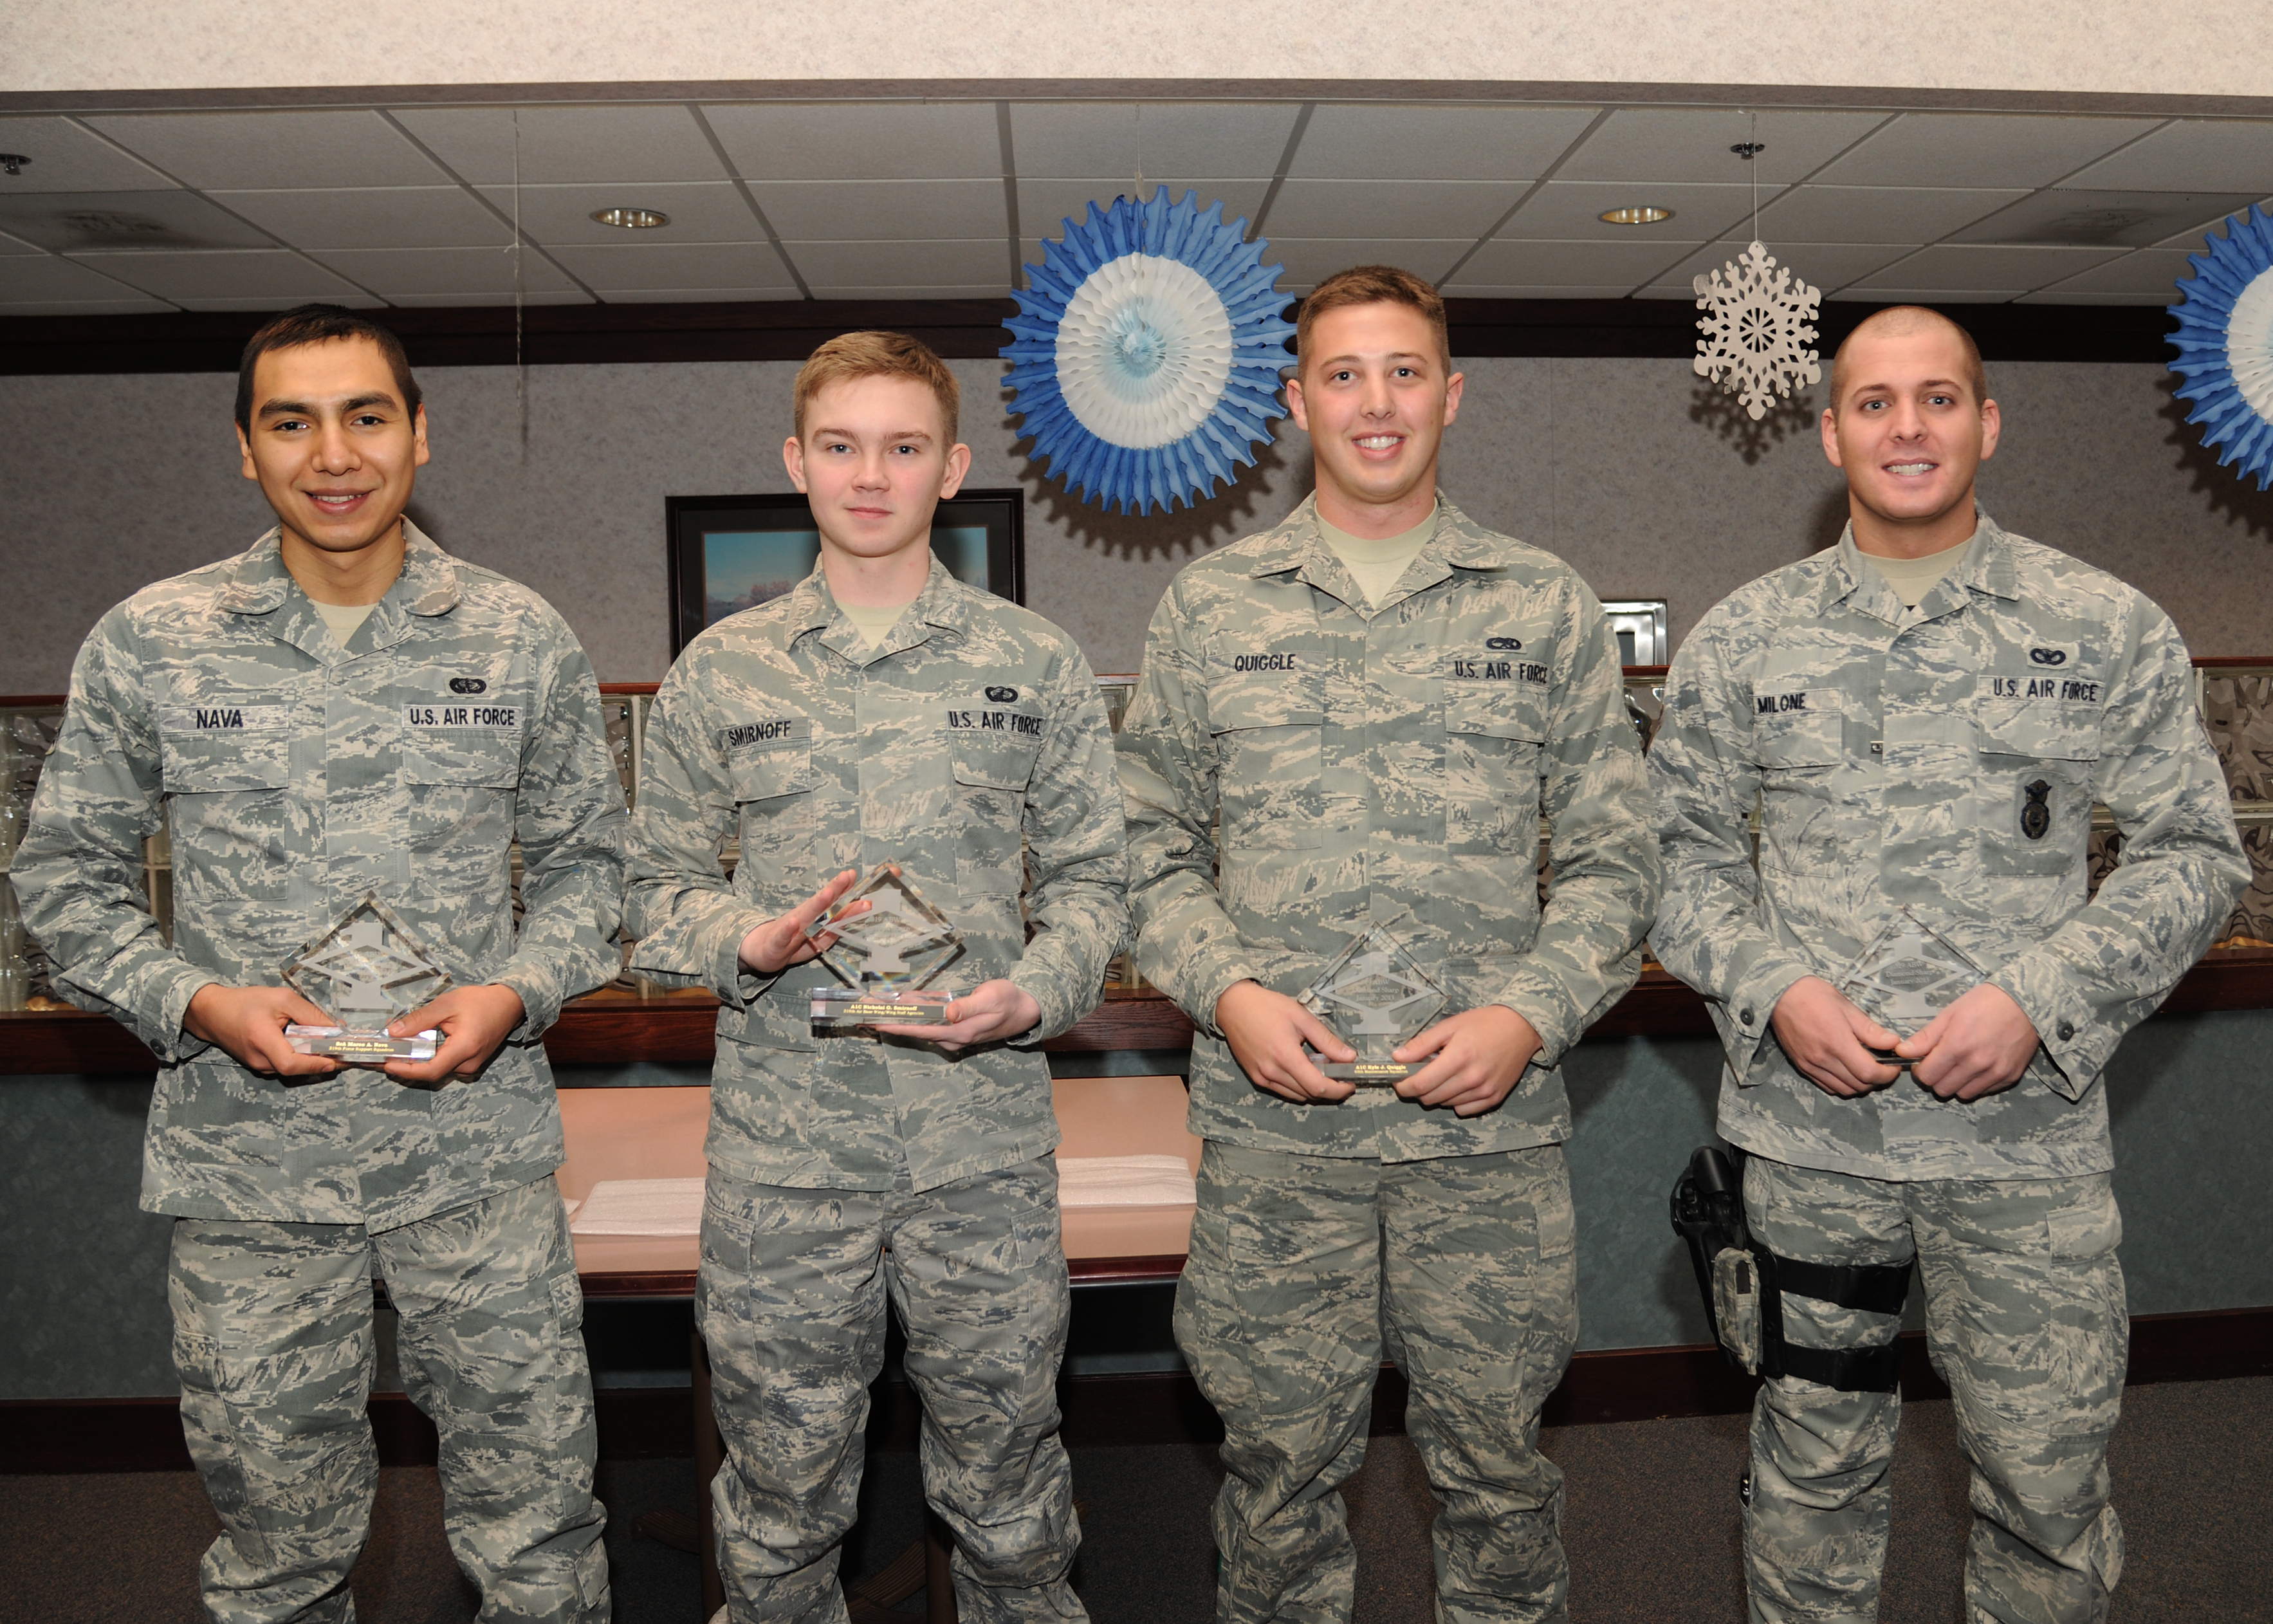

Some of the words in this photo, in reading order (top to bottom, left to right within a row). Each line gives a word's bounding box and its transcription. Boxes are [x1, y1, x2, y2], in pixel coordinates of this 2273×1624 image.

[1234, 654, 1296, 672] QUIGGLE
[1454, 660, 1479, 679] U.S.
[1486, 662, 1511, 679] AIR
[1520, 663, 1547, 684] FORCE
[1994, 678, 2020, 697] U.S.
[2027, 679, 2055, 697] AIR
[2062, 681, 2097, 702] FORCE
[1757, 692, 1806, 714] MILONE
[196, 709, 243, 728] NAVA
[410, 708, 438, 725] U.S.
[443, 708, 468, 725] AIR
[474, 708, 515, 726] FORCE
[949, 711, 975, 729] U.S.
[982, 712, 1004, 730] AIR
[1011, 714, 1043, 735] FORCE
[728, 720, 792, 747] SMIRNOFF
